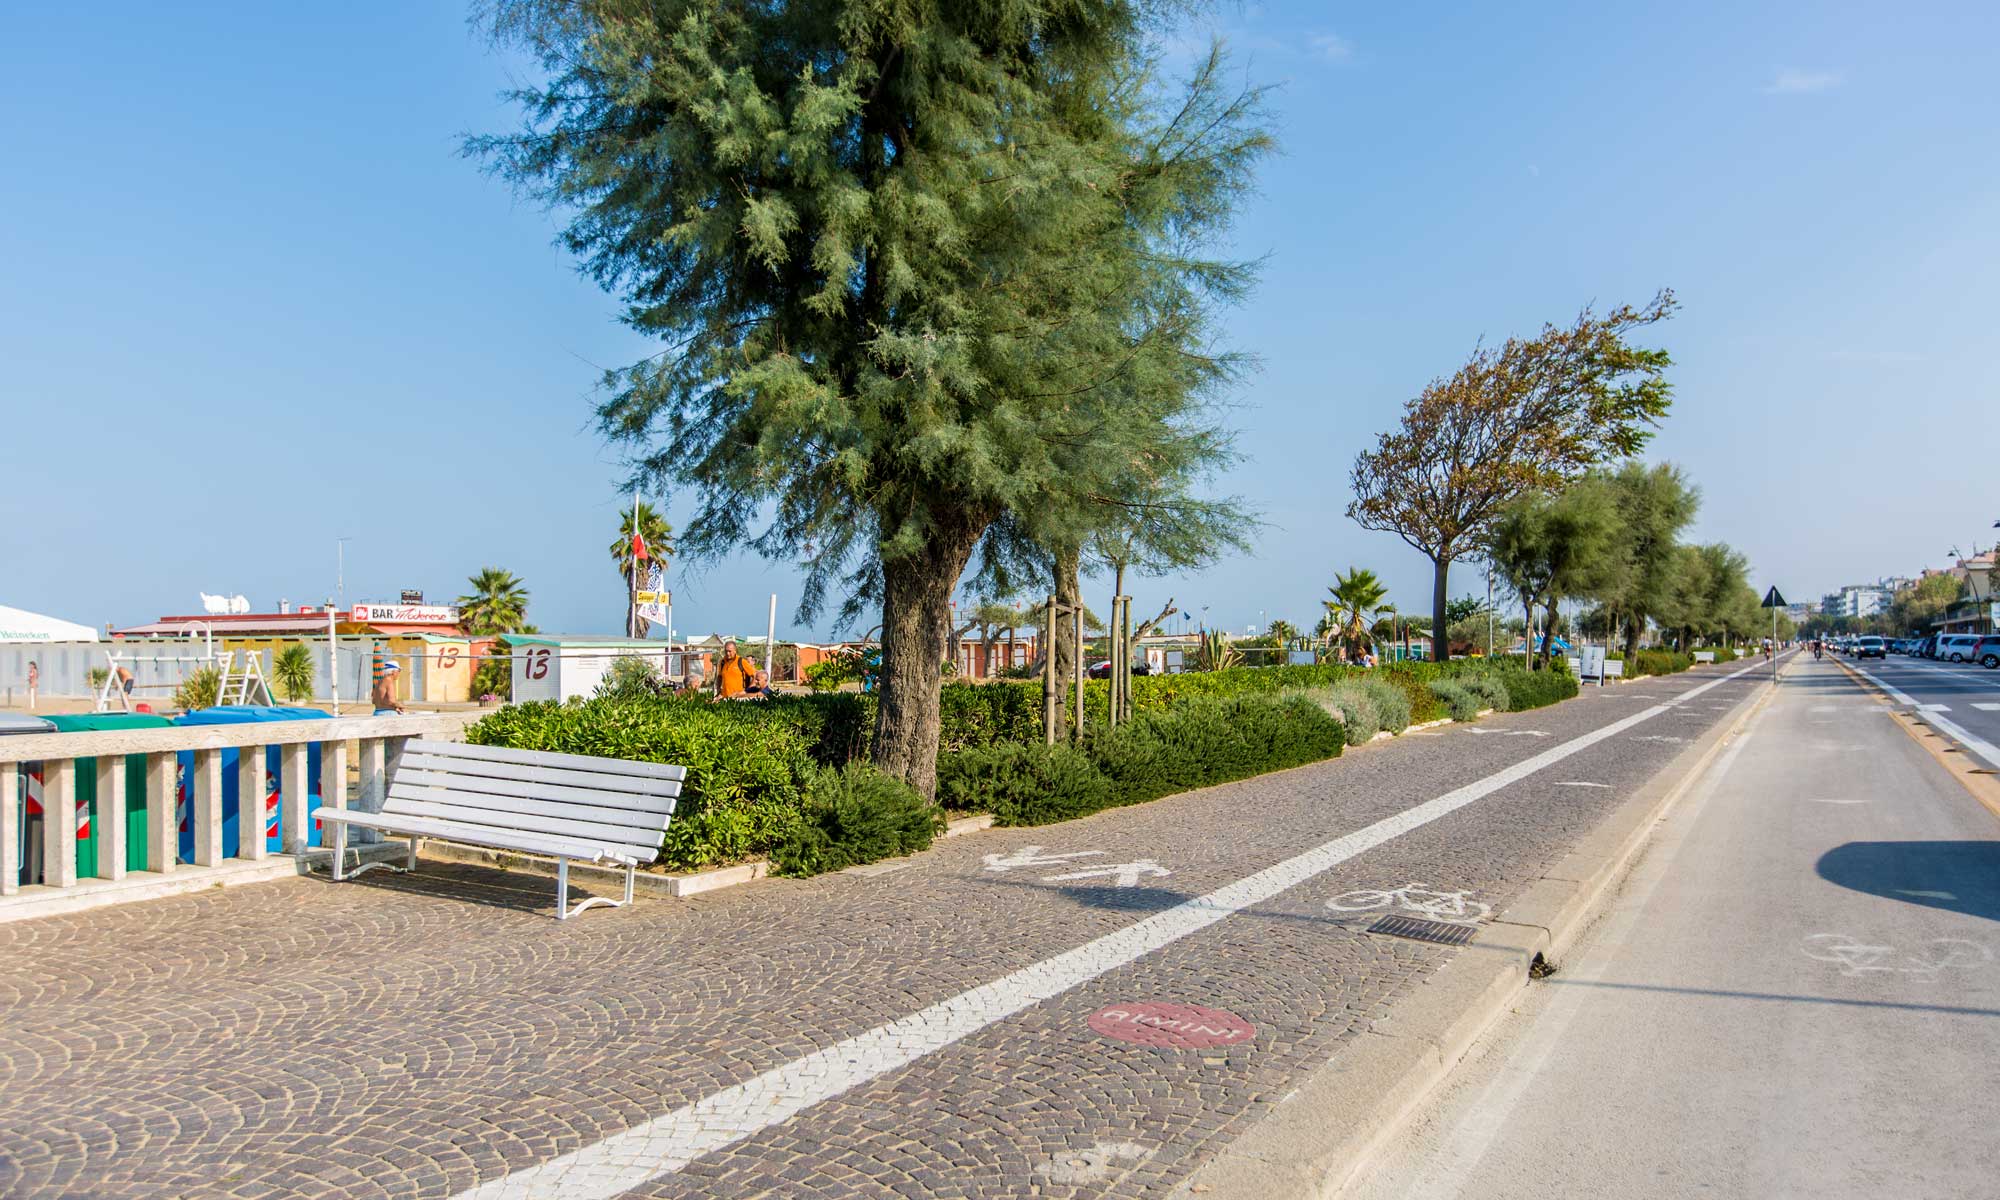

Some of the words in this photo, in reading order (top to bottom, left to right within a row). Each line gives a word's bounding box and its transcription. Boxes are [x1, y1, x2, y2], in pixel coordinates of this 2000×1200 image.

[372, 608, 393, 619] BAR
[437, 647, 459, 669] 13
[525, 648, 551, 680] 13
[1102, 1010, 1241, 1039] RIMINI
